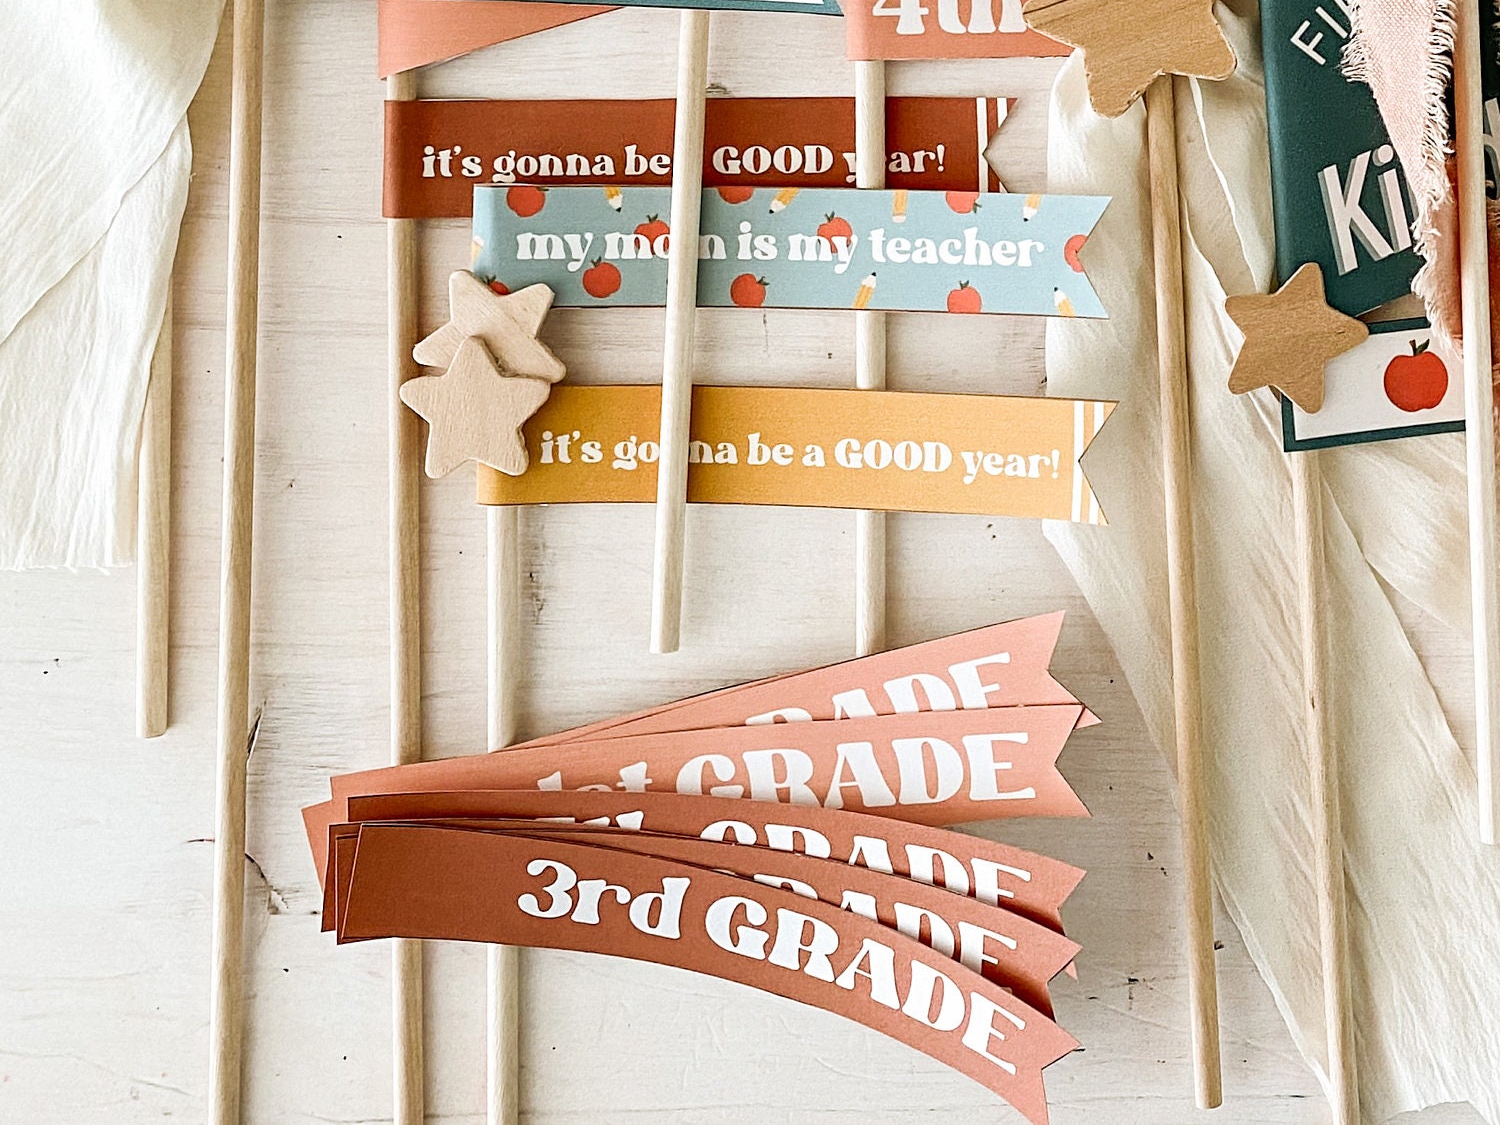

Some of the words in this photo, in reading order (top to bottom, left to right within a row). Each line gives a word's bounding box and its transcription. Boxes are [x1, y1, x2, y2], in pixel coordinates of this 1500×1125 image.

[422, 145, 482, 178] it's
[492, 151, 609, 185] gonna
[624, 144, 671, 176] be
[712, 144, 834, 175] GOOD
[516, 231, 593, 272] my
[737, 221, 777, 260] is
[788, 236, 857, 274] my
[868, 227, 1045, 268] teacher
[540, 430, 603, 465] it's
[612, 435, 739, 470] gona
[747, 432, 794, 467] be
[803, 442, 825, 469] a
[835, 438, 952, 473] GOOD
[961, 446, 1060, 485] year!
[677, 732, 1037, 809] GRADE
[516, 857, 691, 939] 3rd
[703, 895, 1027, 1076] GRADE
